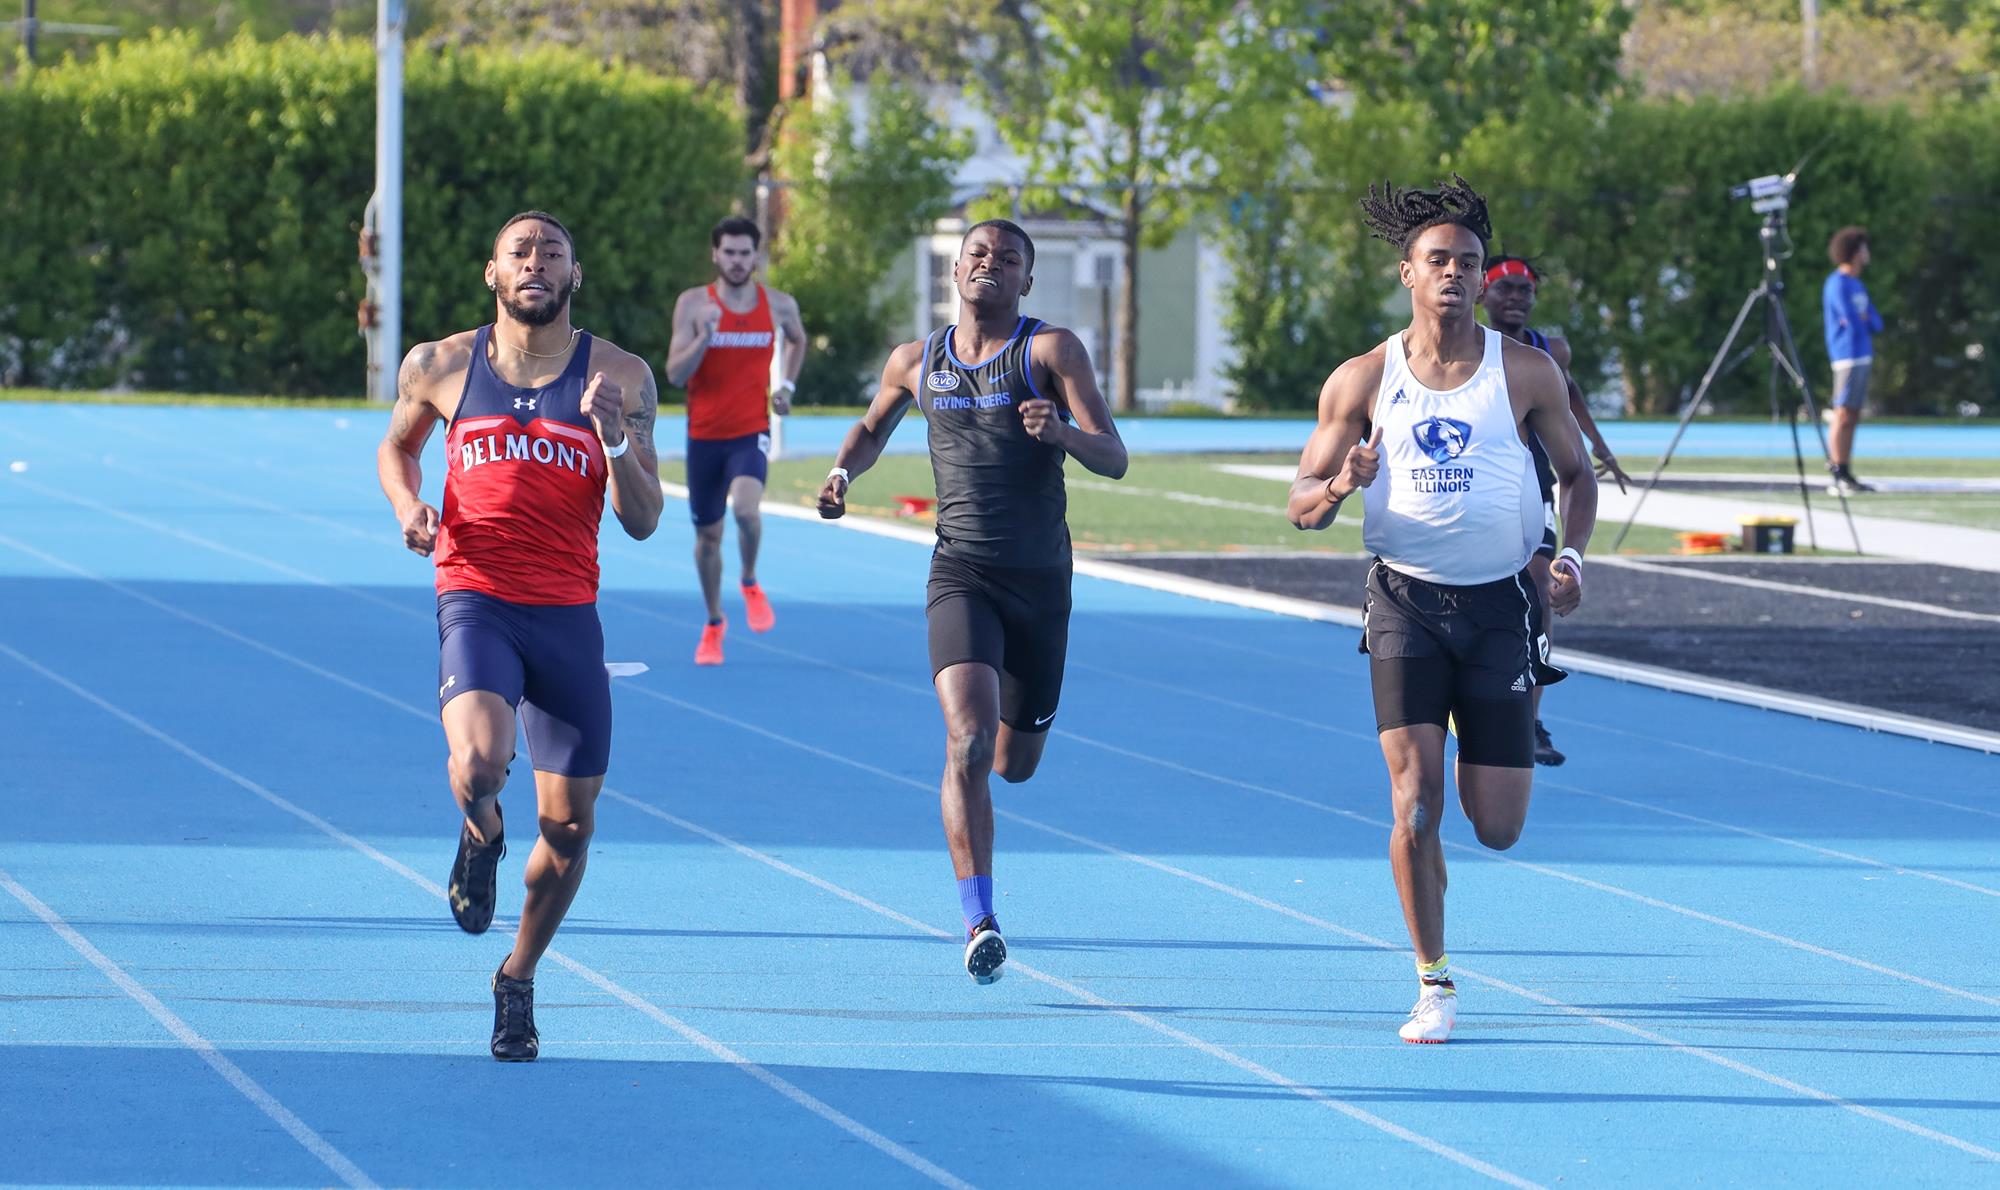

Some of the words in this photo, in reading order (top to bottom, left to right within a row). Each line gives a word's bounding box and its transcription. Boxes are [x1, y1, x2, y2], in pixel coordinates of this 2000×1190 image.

[933, 396, 971, 410] FLYING
[974, 392, 1011, 409] TIGERS
[460, 433, 590, 478] BELMONT
[1411, 468, 1474, 480] EASTERN
[1414, 480, 1471, 493] ILLINOIS
